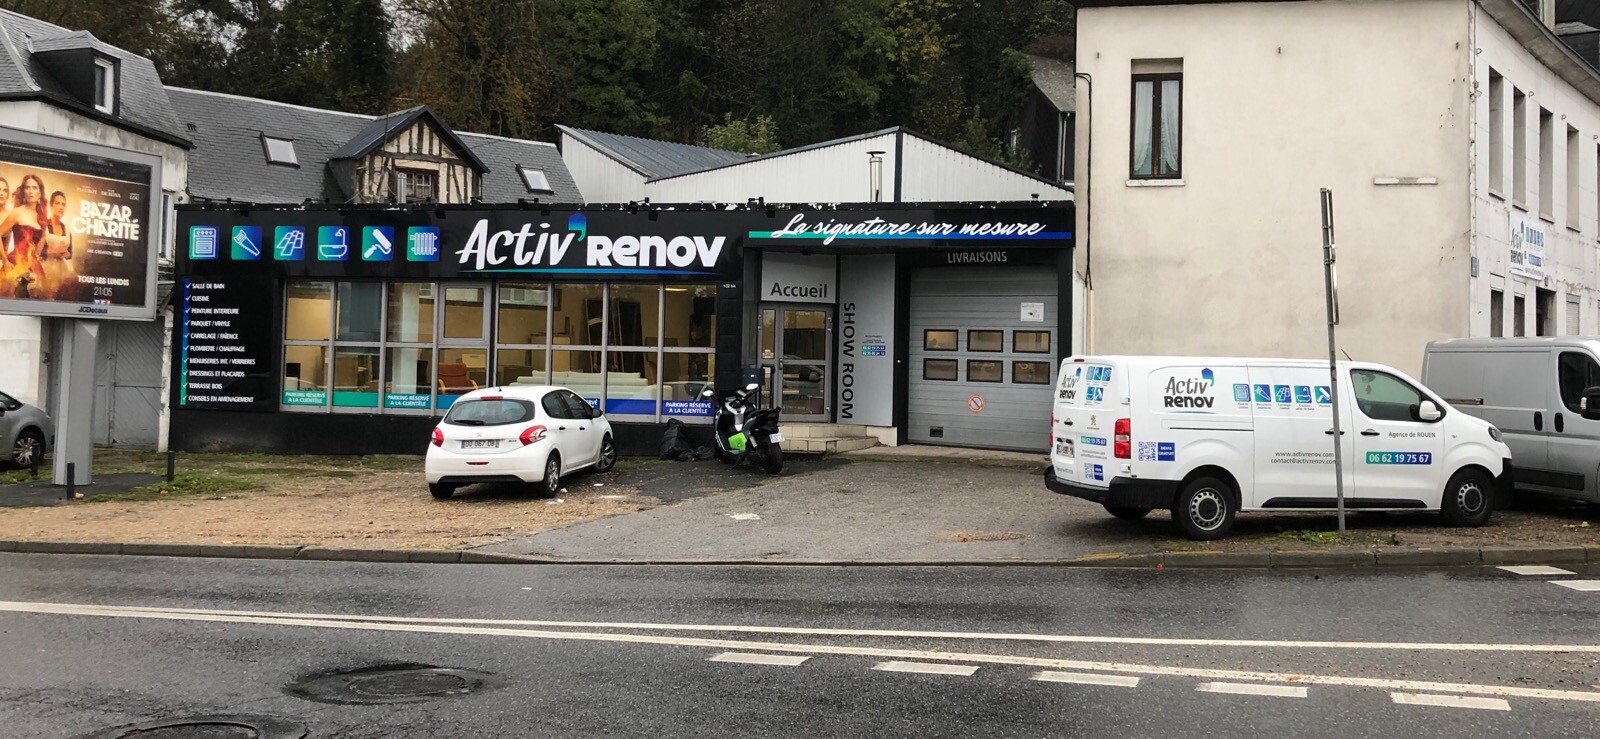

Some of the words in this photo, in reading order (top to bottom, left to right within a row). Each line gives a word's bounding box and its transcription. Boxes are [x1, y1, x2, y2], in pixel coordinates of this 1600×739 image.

[80, 200, 132, 222] BAZAR
[72, 216, 140, 240] CHARITÉ
[771, 214, 811, 237] La
[810, 216, 917, 245] signature
[917, 220, 957, 236] sur
[959, 220, 1046, 236] mesure
[948, 250, 1008, 264] LIVRAISONS
[78, 276, 95, 284] TOUS
[108, 278, 130, 286] LUNDIS
[94, 286, 112, 296] 21:05
[770, 282, 828, 298] Accueil
[842, 302, 856, 358] SHOW
[842, 364, 854, 419] ROOM
[689, 401, 712, 409] RÉSERVÉ
[1369, 454, 1380, 462] 06
[1382, 454, 1392, 462] 62
[1395, 454, 1404, 462] 19
[1407, 454, 1417, 462] 75
[1419, 454, 1430, 463] 67
